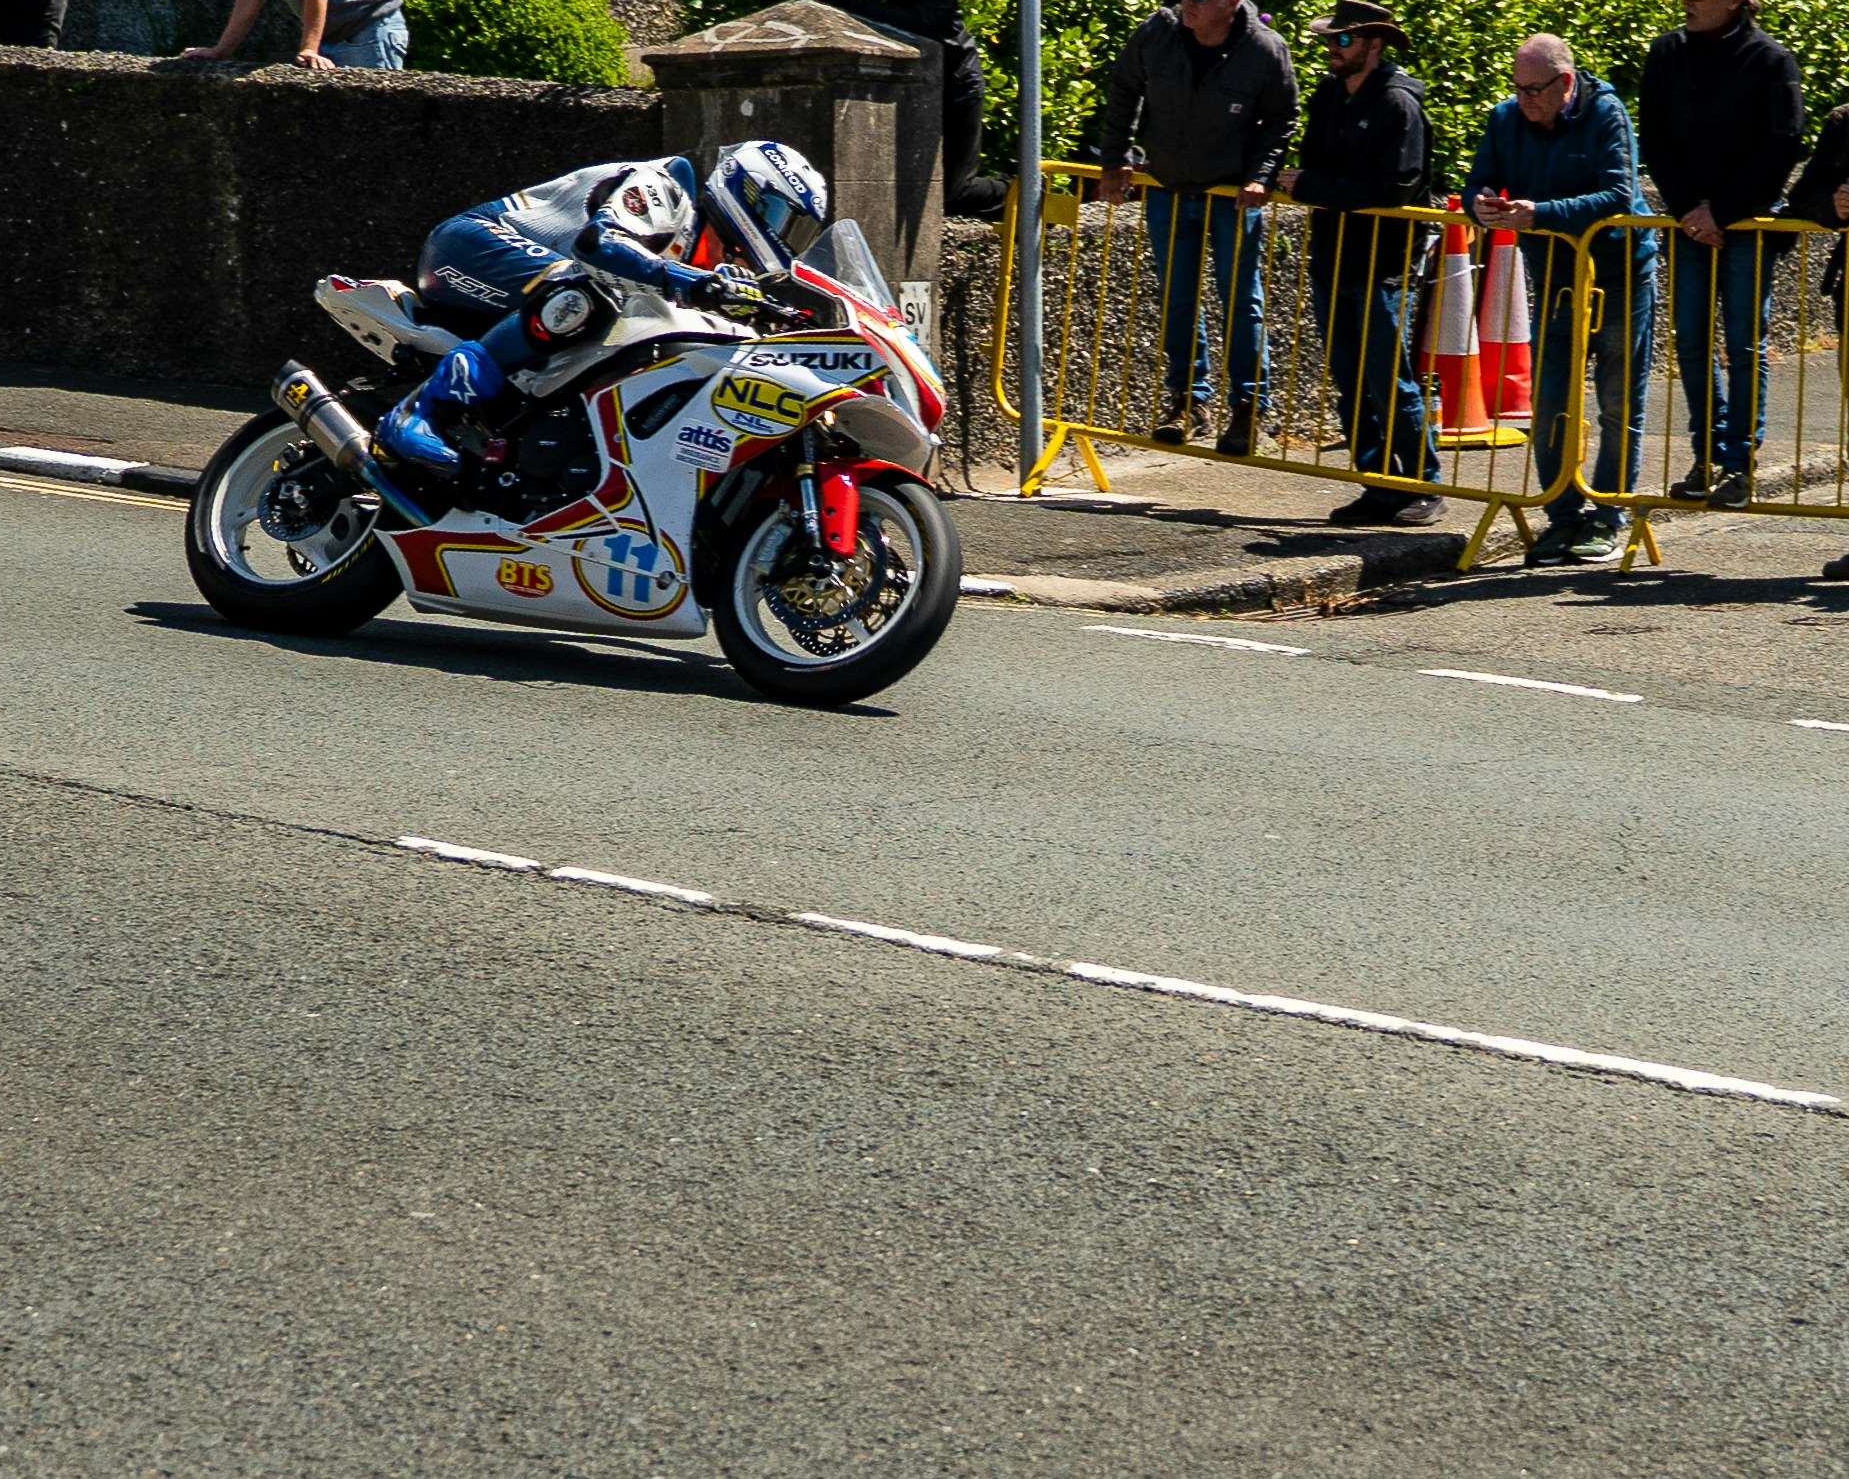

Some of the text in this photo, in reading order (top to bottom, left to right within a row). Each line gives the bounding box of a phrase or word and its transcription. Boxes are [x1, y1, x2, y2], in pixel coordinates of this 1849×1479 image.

[764, 149, 808, 194] CONROD
[434, 265, 509, 299] RST
[905, 302, 926, 325] SV
[749, 352, 872, 371] SUZUKI
[718, 376, 805, 419] NLC
[500, 557, 551, 590] BTS
[604, 533, 659, 603] 11
